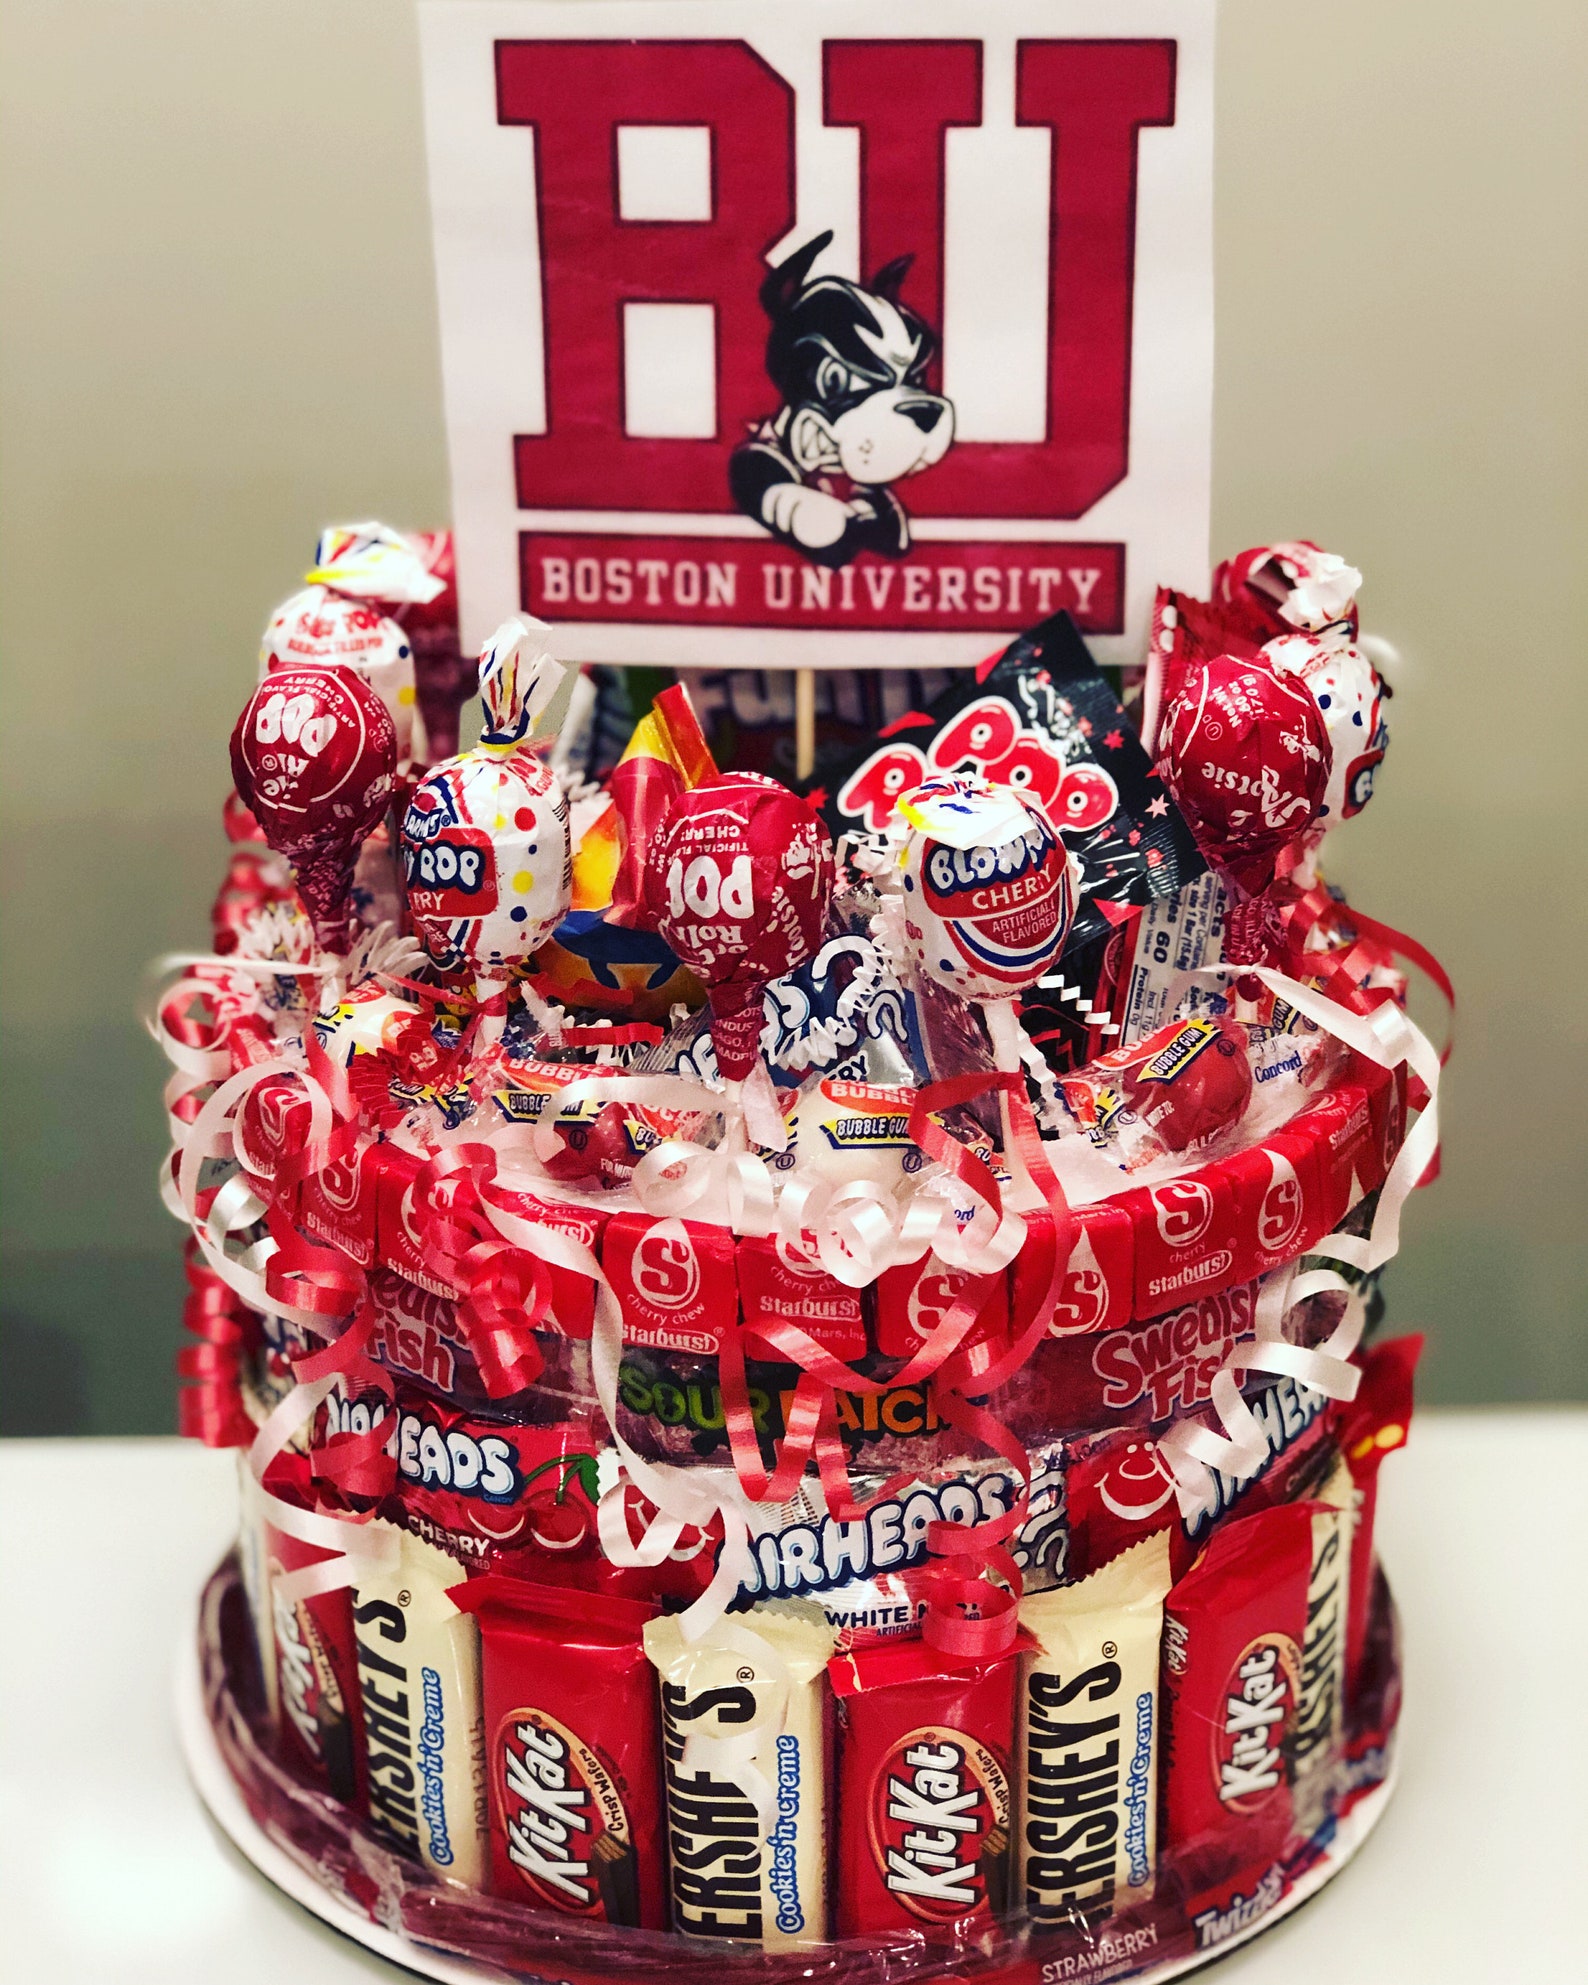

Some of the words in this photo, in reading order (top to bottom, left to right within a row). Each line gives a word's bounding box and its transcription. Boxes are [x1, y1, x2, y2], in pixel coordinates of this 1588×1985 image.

[494, 39, 1178, 520] BU
[542, 557, 738, 609] BOSTON
[763, 564, 1103, 617] UNIVERSITY
[421, 846, 480, 887] POP
[1002, 911, 1058, 945] FLAVORED
[1153, 931, 1170, 964] 60
[1134, 966, 1149, 1010] Protein
[1150, 1042, 1185, 1076] BUBBLE
[1179, 1027, 1204, 1048] GUM
[1254, 1050, 1302, 1083] Concord
[836, 1116, 886, 1138] BUBBLE
[397, 1231, 426, 1269] cherry
[1148, 1252, 1227, 1296] Starburst
[627, 1292, 668, 1326] cherry
[672, 1302, 705, 1324] chew
[760, 1296, 858, 1319] Starburst
[407, 1514, 490, 1557] CHERRY
[823, 1605, 909, 1629] WHITE
[580, 1748, 610, 1793] Wafers
[601, 1793, 624, 1832] Crisp
[1041, 1924, 1158, 1984] STRAWBERRY
